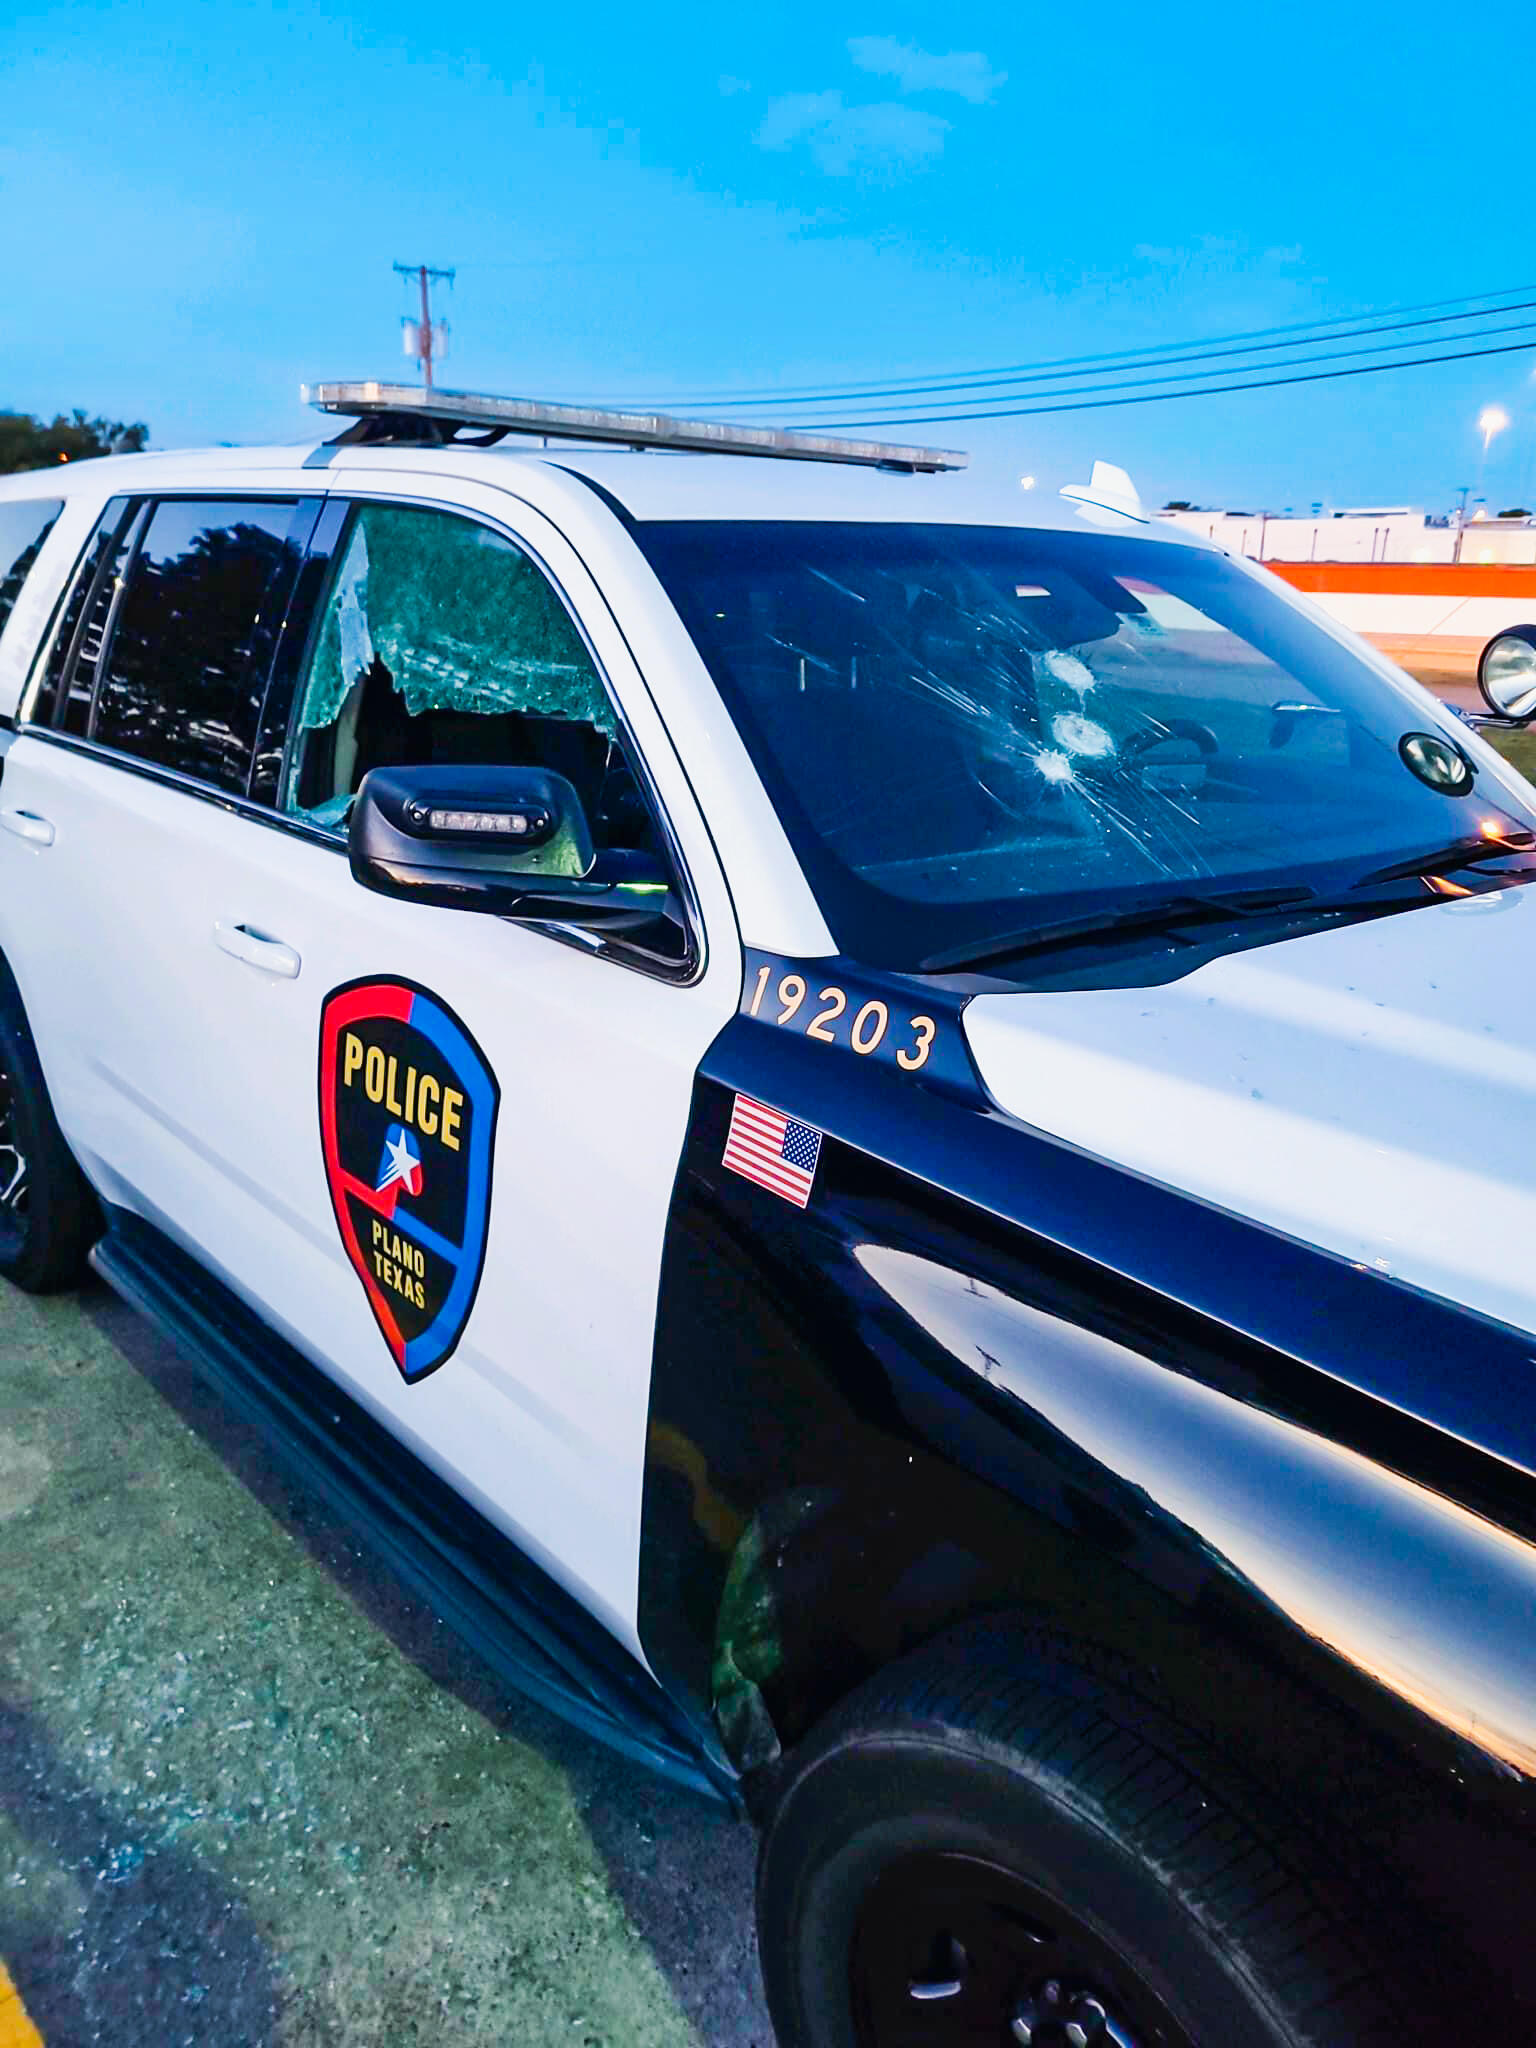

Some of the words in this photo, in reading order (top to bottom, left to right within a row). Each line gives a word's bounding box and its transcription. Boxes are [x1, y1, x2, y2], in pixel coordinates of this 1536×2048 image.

[750, 966, 936, 1071] 19203
[343, 1032, 464, 1152] POLICE
[372, 1218, 425, 1279] PLANO
[374, 1250, 425, 1310] TEXAS
